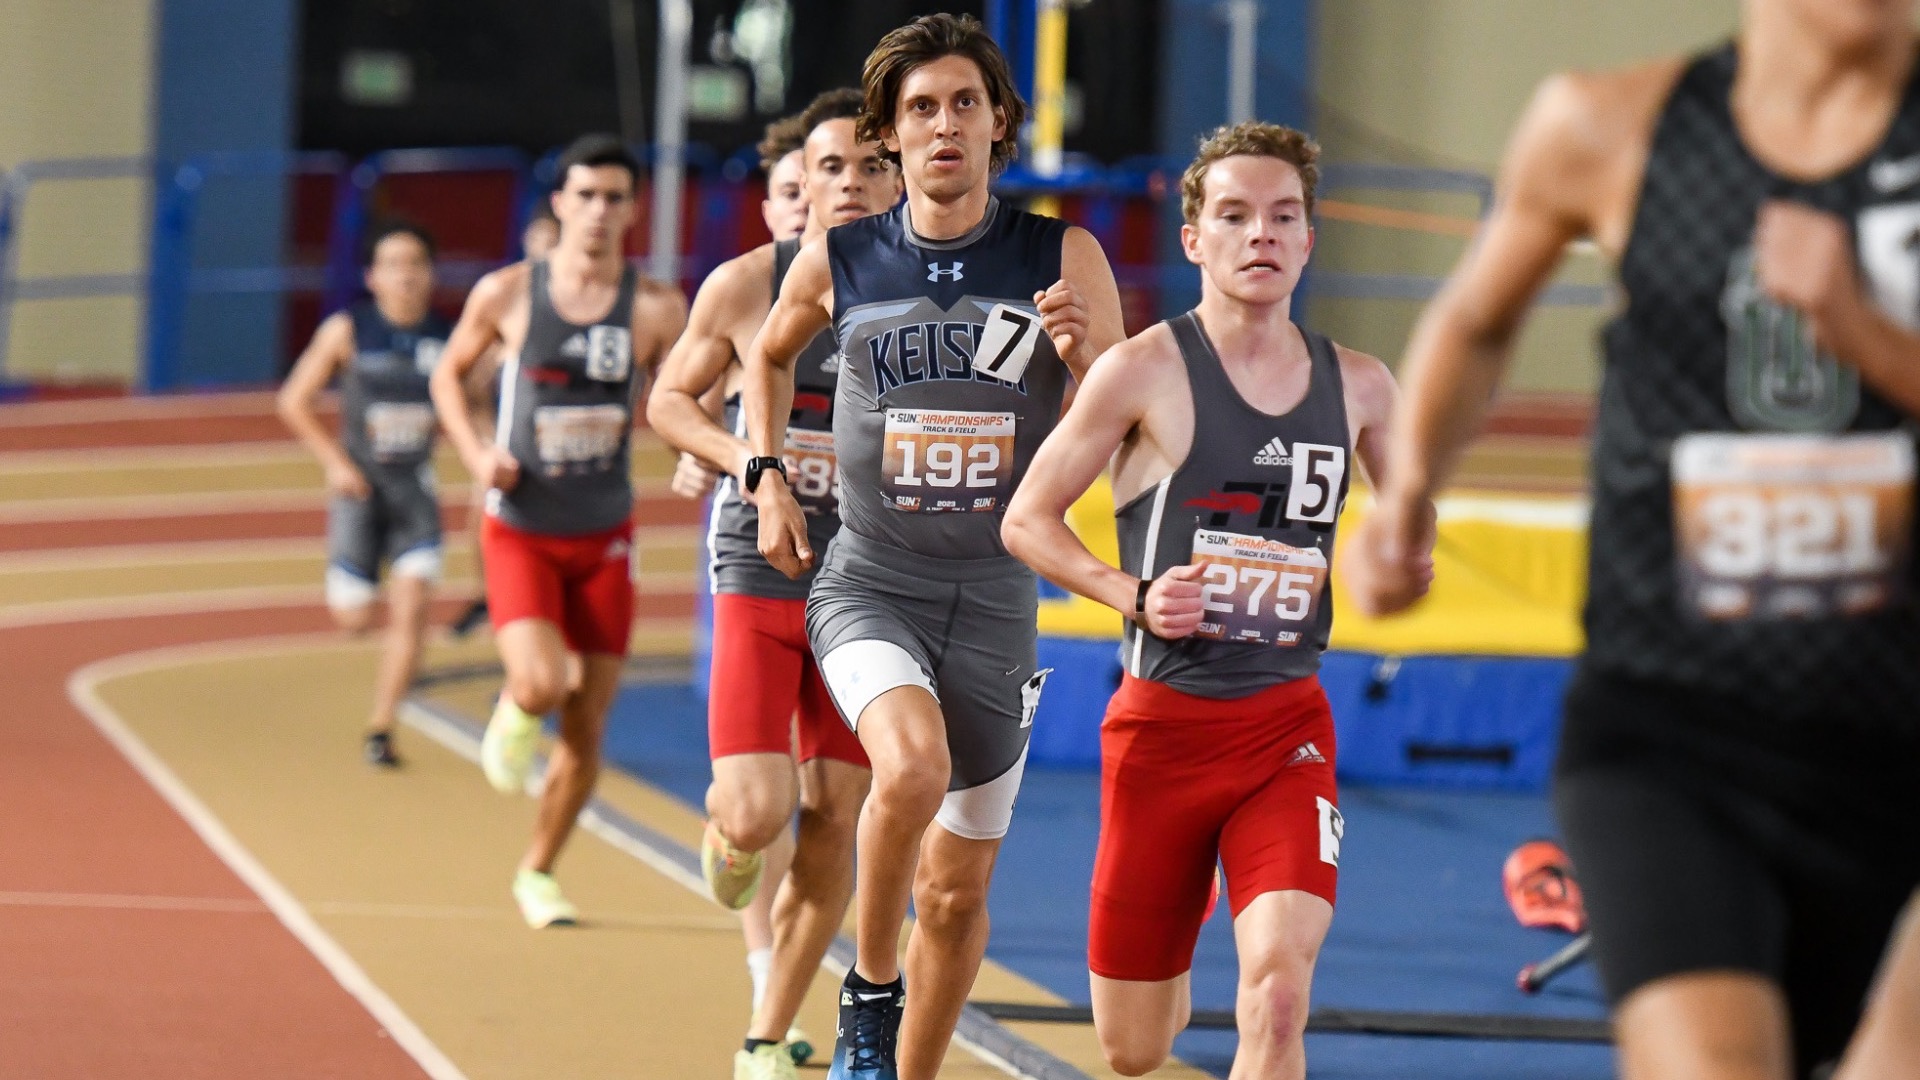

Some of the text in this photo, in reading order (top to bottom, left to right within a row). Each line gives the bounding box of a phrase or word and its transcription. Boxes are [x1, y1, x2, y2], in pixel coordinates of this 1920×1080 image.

[868, 321, 1028, 399] KEIS
[987, 309, 1031, 373] 7
[894, 440, 1000, 488] 192
[1253, 455, 1294, 465] adidas
[1300, 449, 1334, 517] 5
[1234, 549, 1260, 558] TRACK
[1267, 552, 1290, 562] FIELD
[1202, 563, 1314, 620] 275
